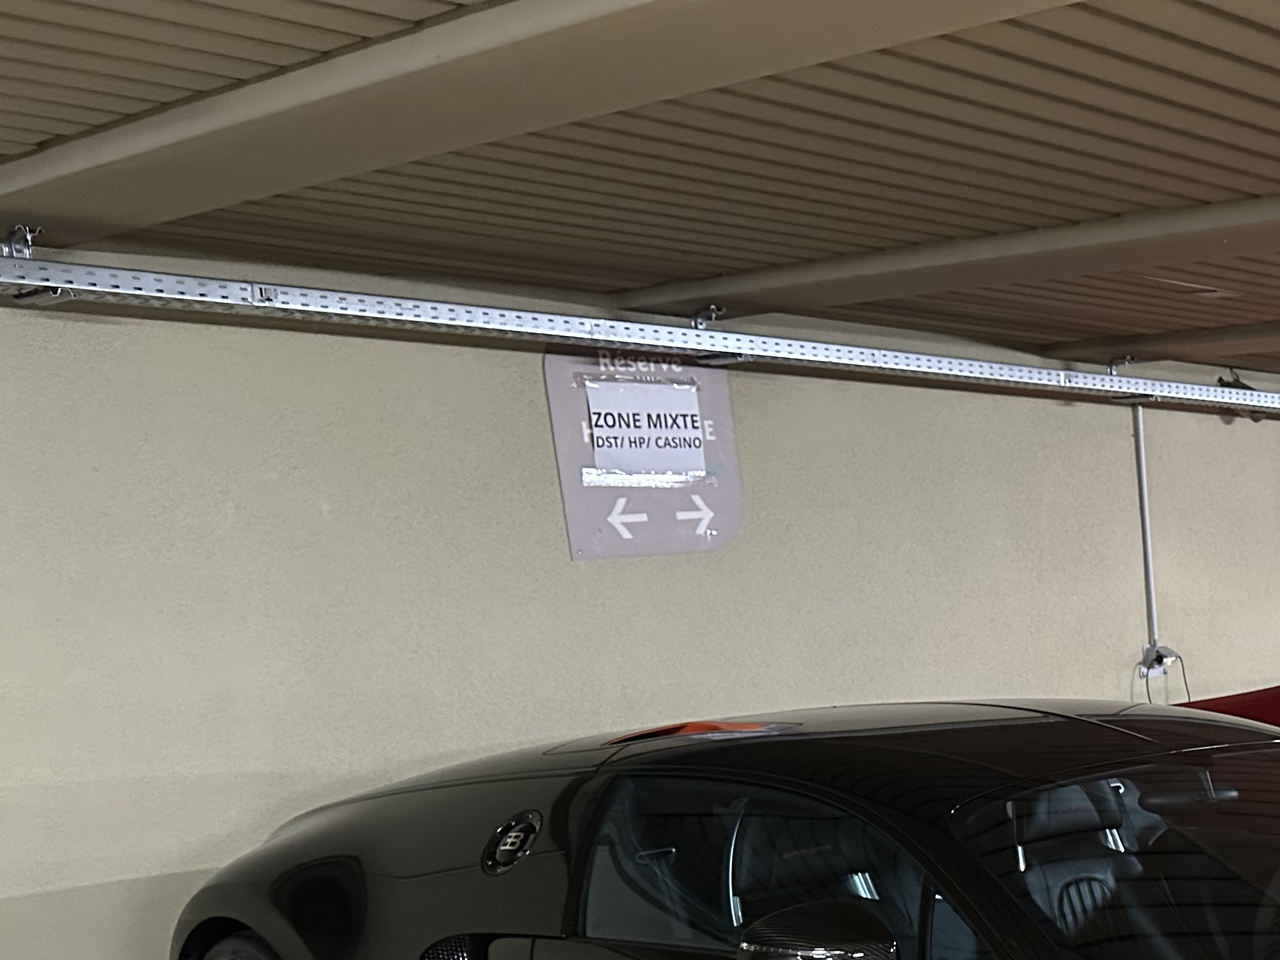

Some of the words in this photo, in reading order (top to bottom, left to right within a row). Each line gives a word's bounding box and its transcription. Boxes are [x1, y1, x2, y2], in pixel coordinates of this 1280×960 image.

[592, 411, 641, 429] ZONE
[646, 412, 700, 430] MIXTE
[596, 436, 624, 449] DST/
[628, 436, 650, 449] HP/
[655, 436, 702, 449] CASINO
